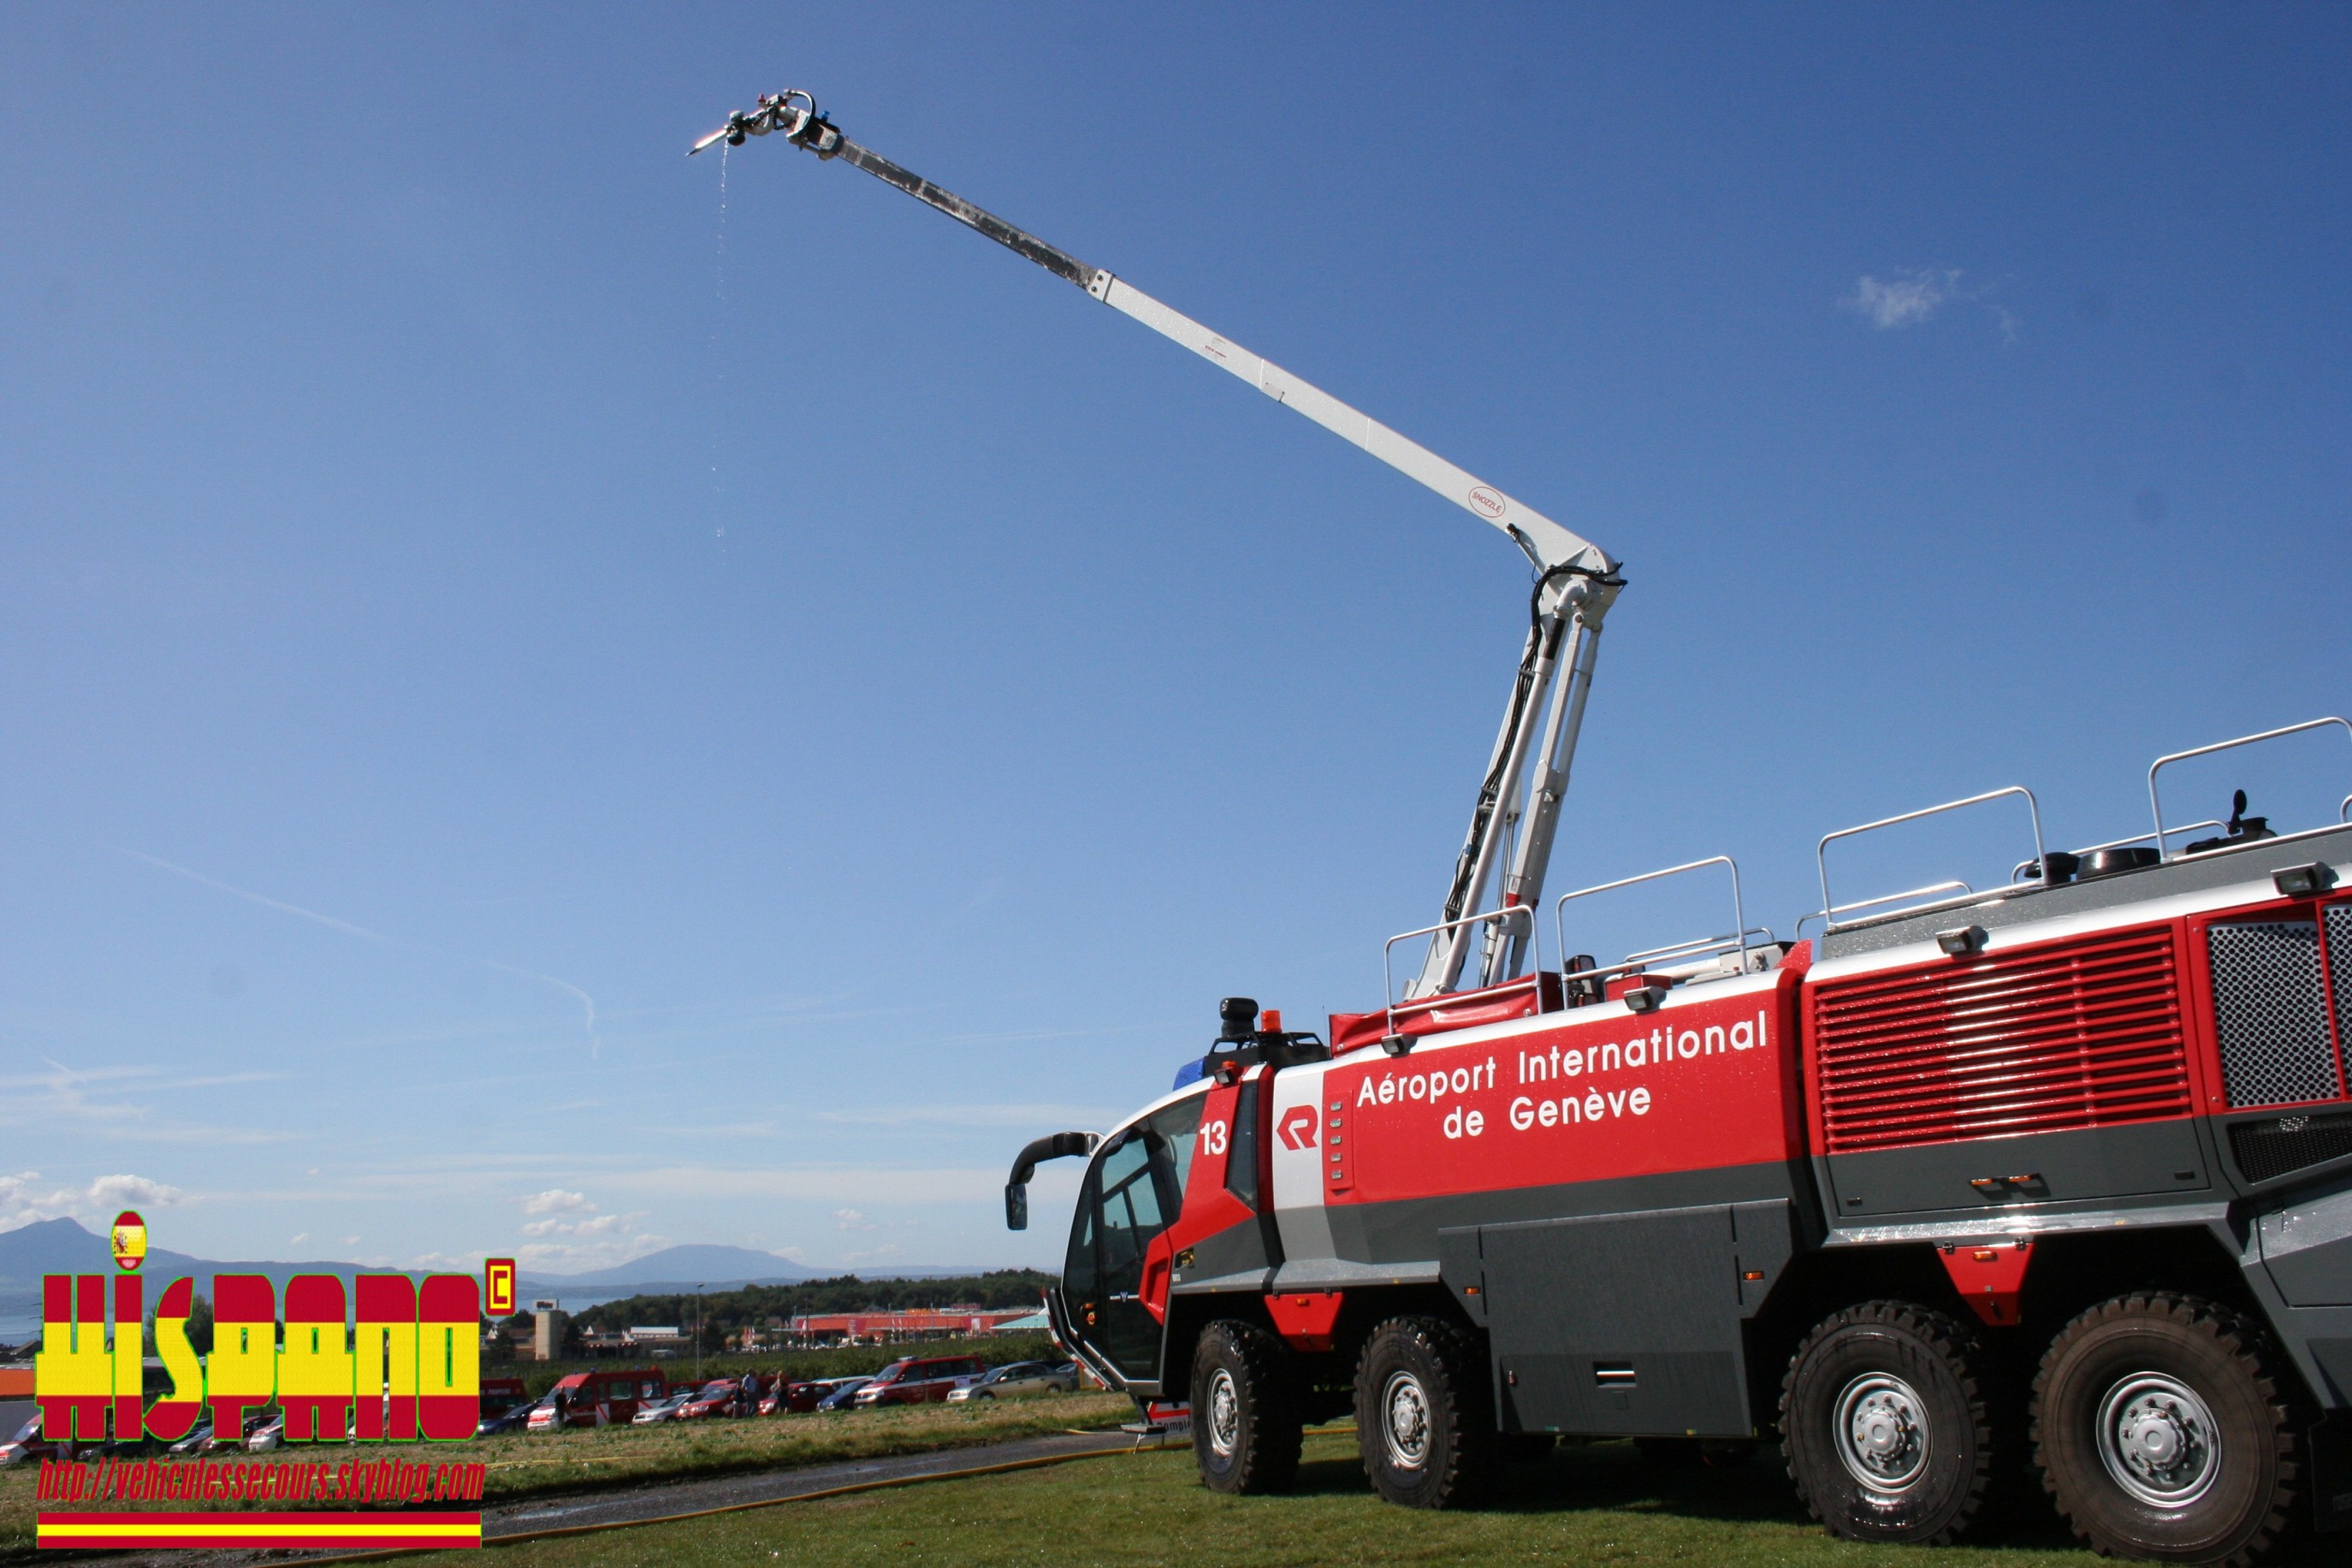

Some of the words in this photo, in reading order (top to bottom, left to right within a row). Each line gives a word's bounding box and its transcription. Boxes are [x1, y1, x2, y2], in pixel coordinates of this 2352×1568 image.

[1472, 492, 1502, 514] SNOZZLE
[1356, 1056, 1496, 1108] Aéroport
[1519, 1009, 1767, 1084] International
[1443, 1105, 1484, 1139] de
[1509, 1086, 1651, 1131] Genève
[1200, 1120, 1227, 1156] 13
